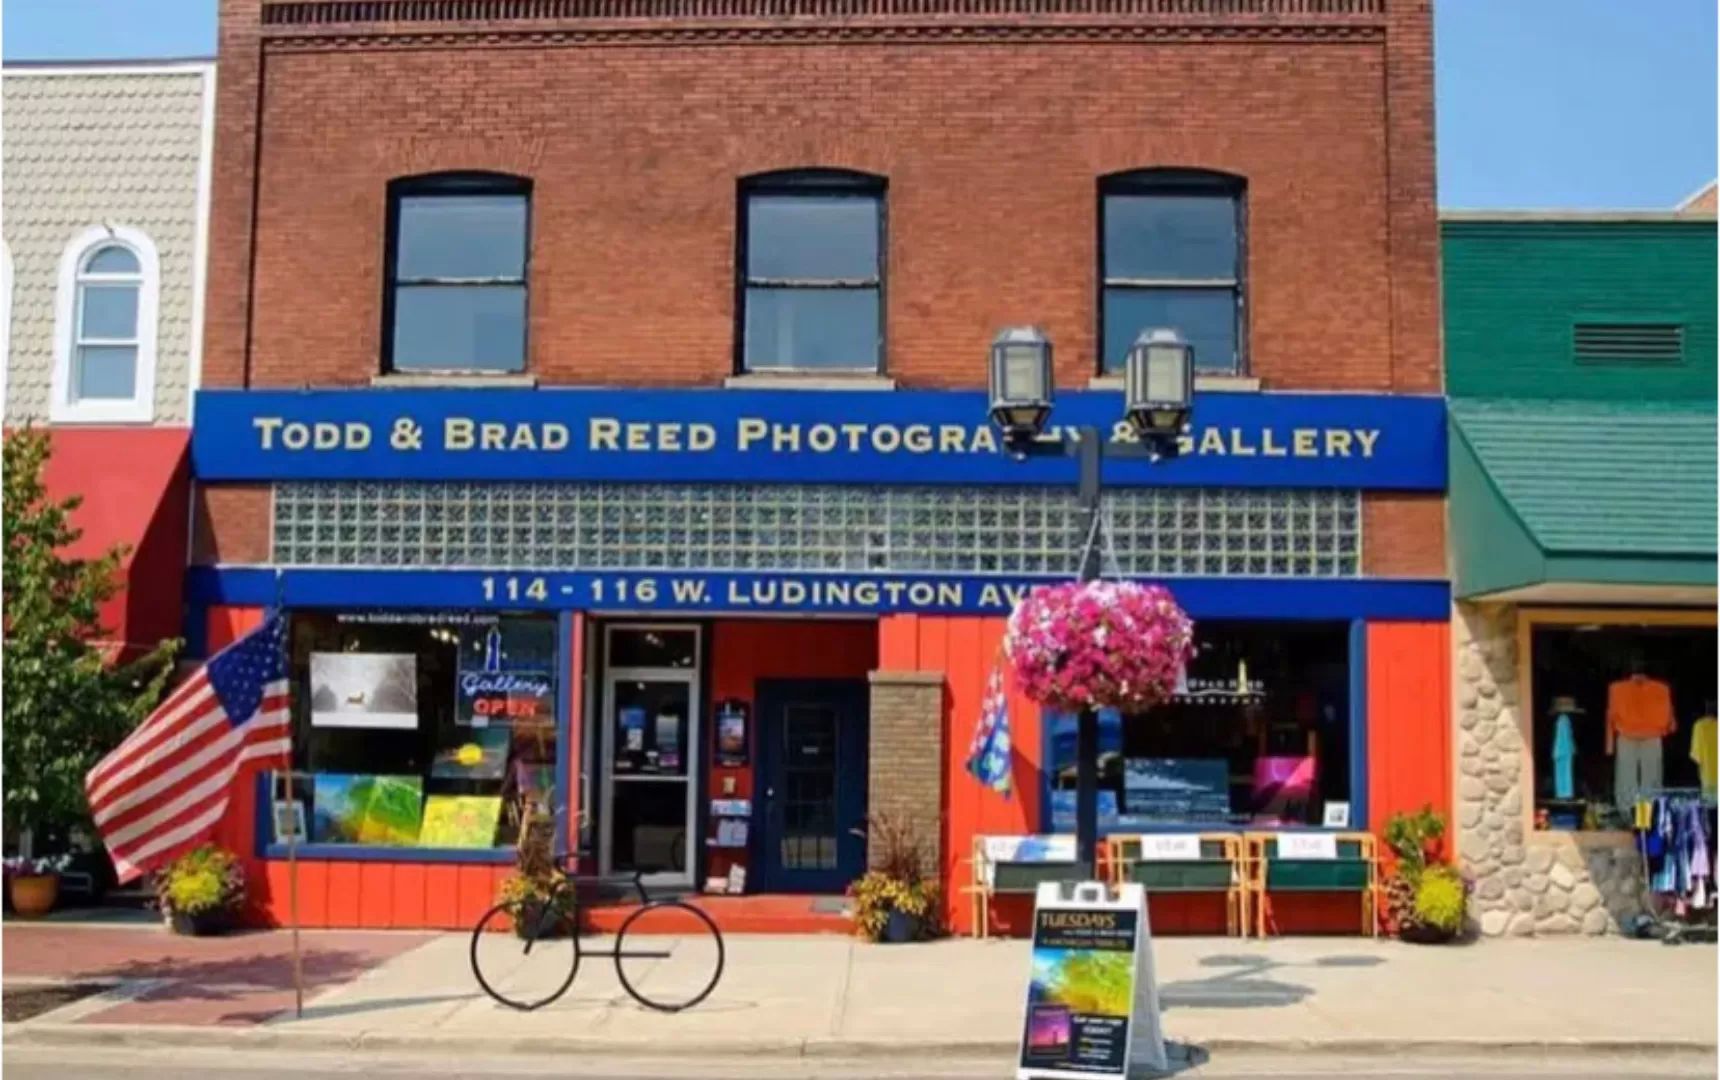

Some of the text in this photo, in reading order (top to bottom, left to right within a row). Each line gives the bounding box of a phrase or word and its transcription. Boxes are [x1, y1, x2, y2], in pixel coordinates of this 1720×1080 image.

[253, 417, 372, 450] TODD
[390, 418, 423, 450] &
[444, 418, 569, 451] BRAD
[589, 418, 717, 451] REED
[737, 418, 1083, 454] PHOTOGRA
[1110, 421, 1141, 443] &
[482, 578, 548, 601] 114
[591, 579, 657, 603] 116
[672, 580, 712, 603] W.
[728, 581, 963, 606] LUDINGTON
[978, 583, 1032, 607] AV
[461, 673, 548, 697] Gallery
[473, 698, 537, 716] OPEN
[1041, 912, 1116, 928] TUESDAYS
